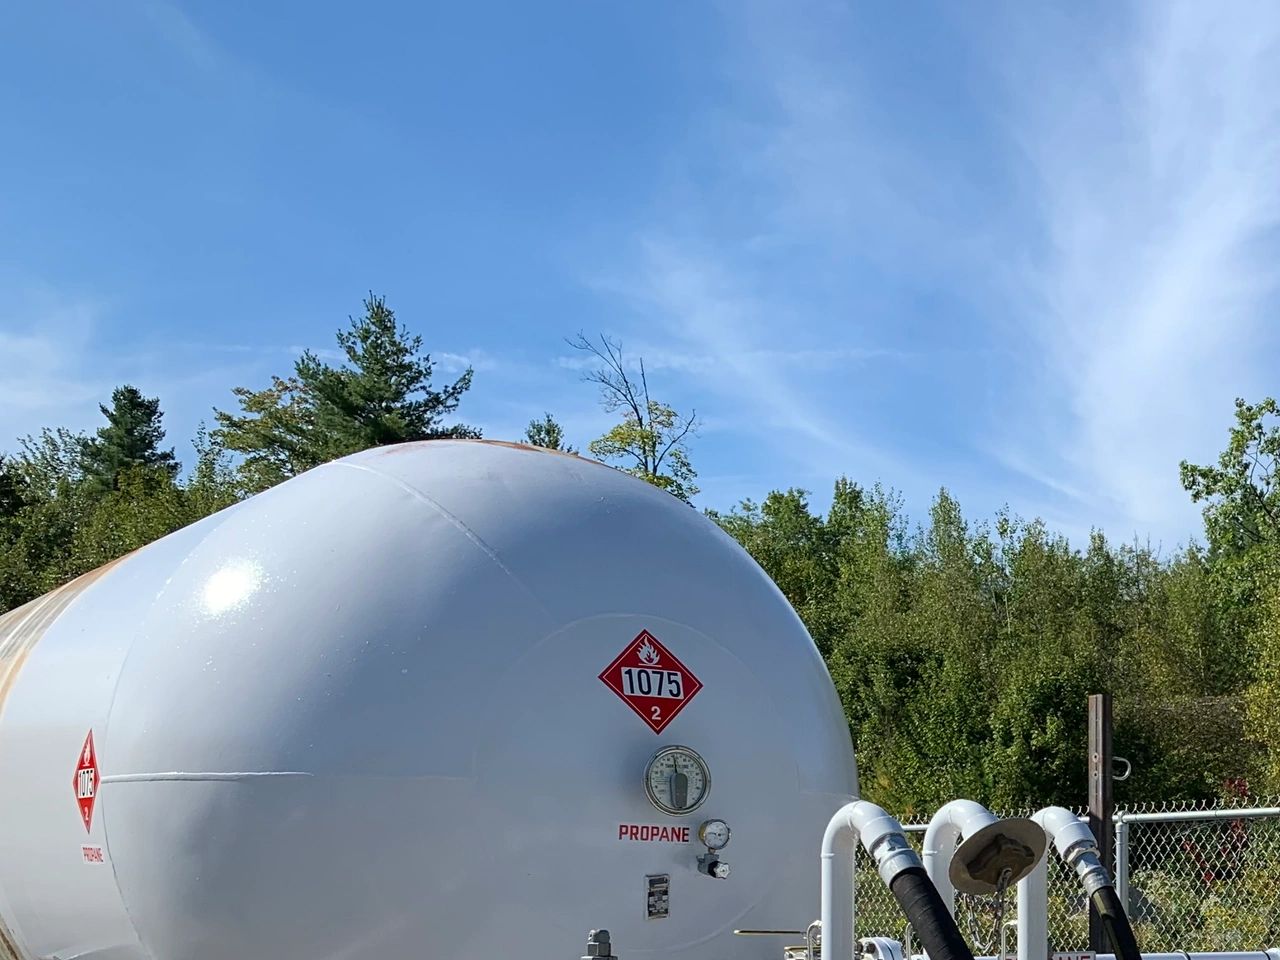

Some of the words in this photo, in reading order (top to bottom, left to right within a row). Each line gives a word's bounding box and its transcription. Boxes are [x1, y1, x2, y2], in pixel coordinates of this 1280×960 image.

[624, 668, 681, 697] 1075
[650, 705, 662, 721] 2
[79, 770, 93, 796] 1075
[84, 806, 89, 820] 2
[618, 825, 690, 843] PROPANE
